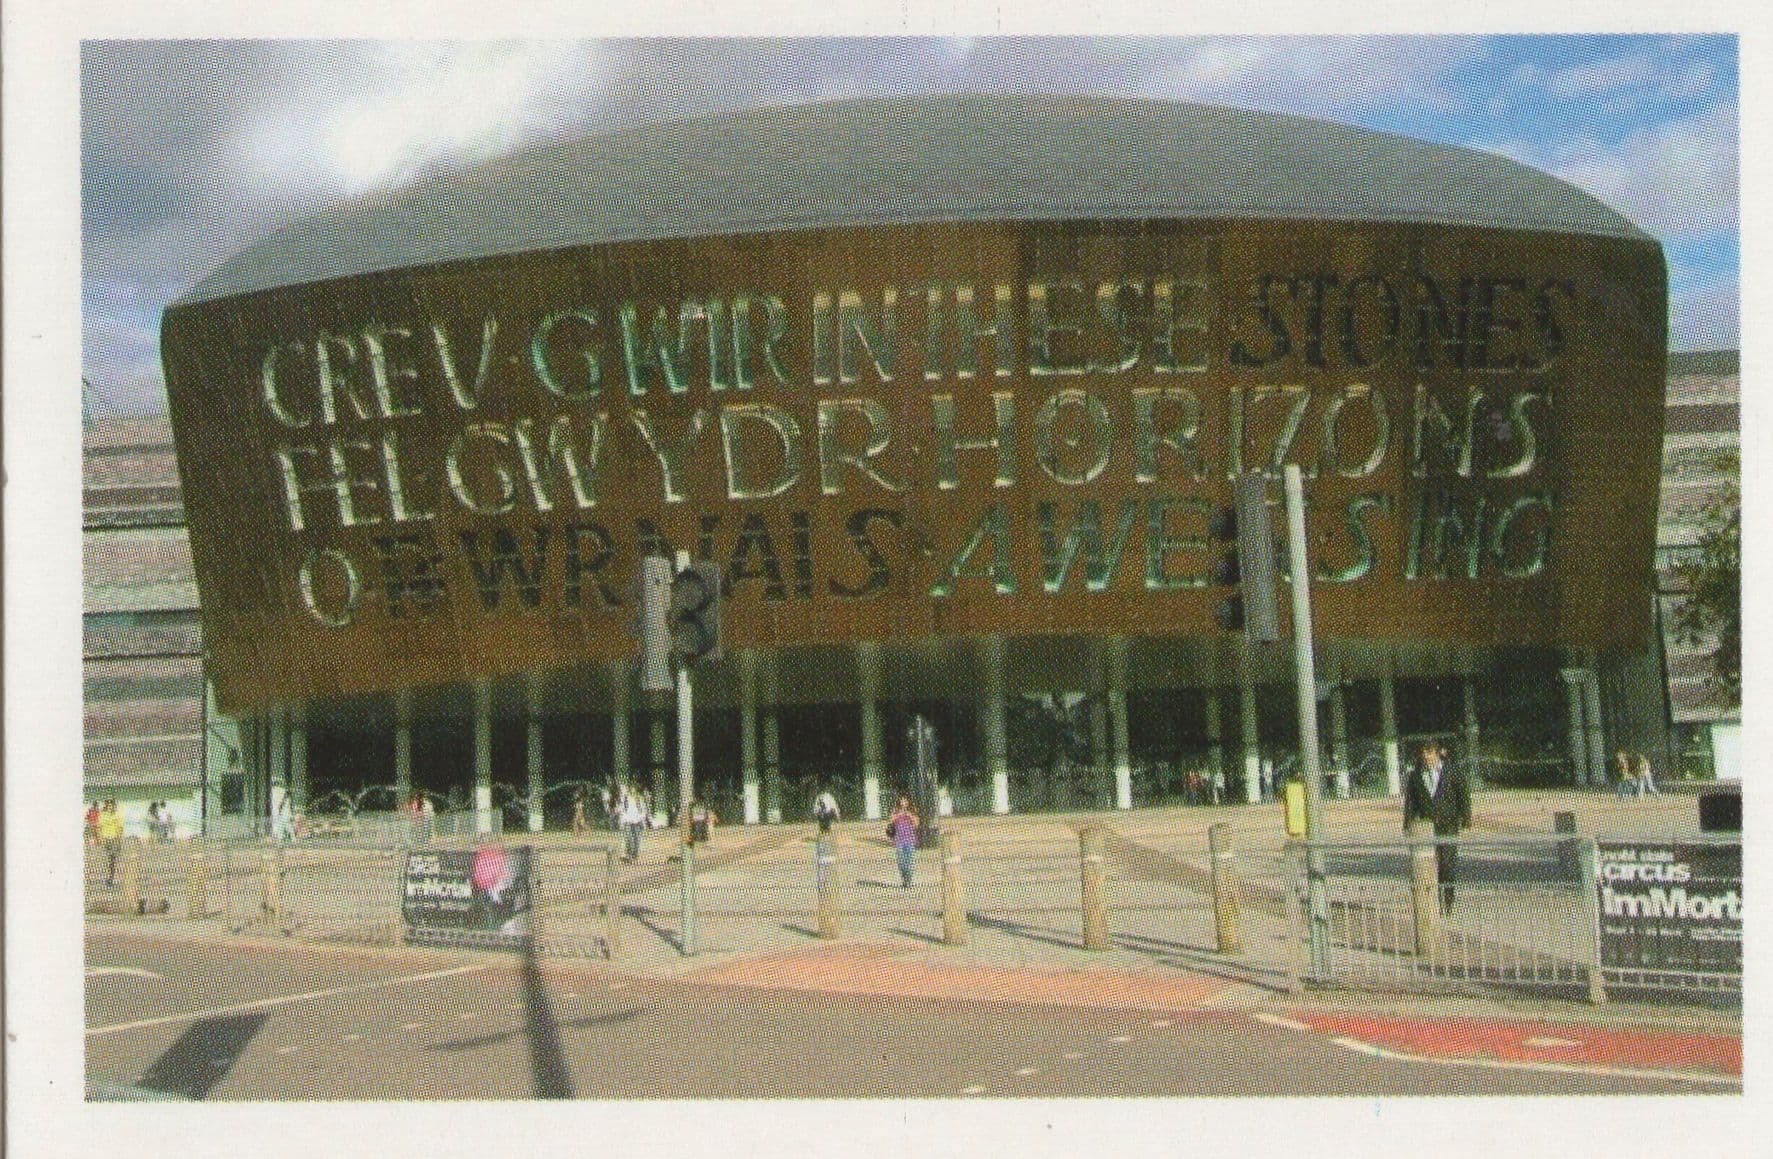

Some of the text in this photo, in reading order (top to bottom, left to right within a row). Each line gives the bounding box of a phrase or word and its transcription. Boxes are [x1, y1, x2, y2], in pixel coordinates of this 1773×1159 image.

[906, 279, 1207, 379] THESE
[1230, 270, 1575, 374] STONES
[446, 398, 904, 514] GWYDR
[931, 384, 1553, 489] HORIZONS
[928, 496, 1312, 597] AWE
[1603, 863, 1691, 881] circus
